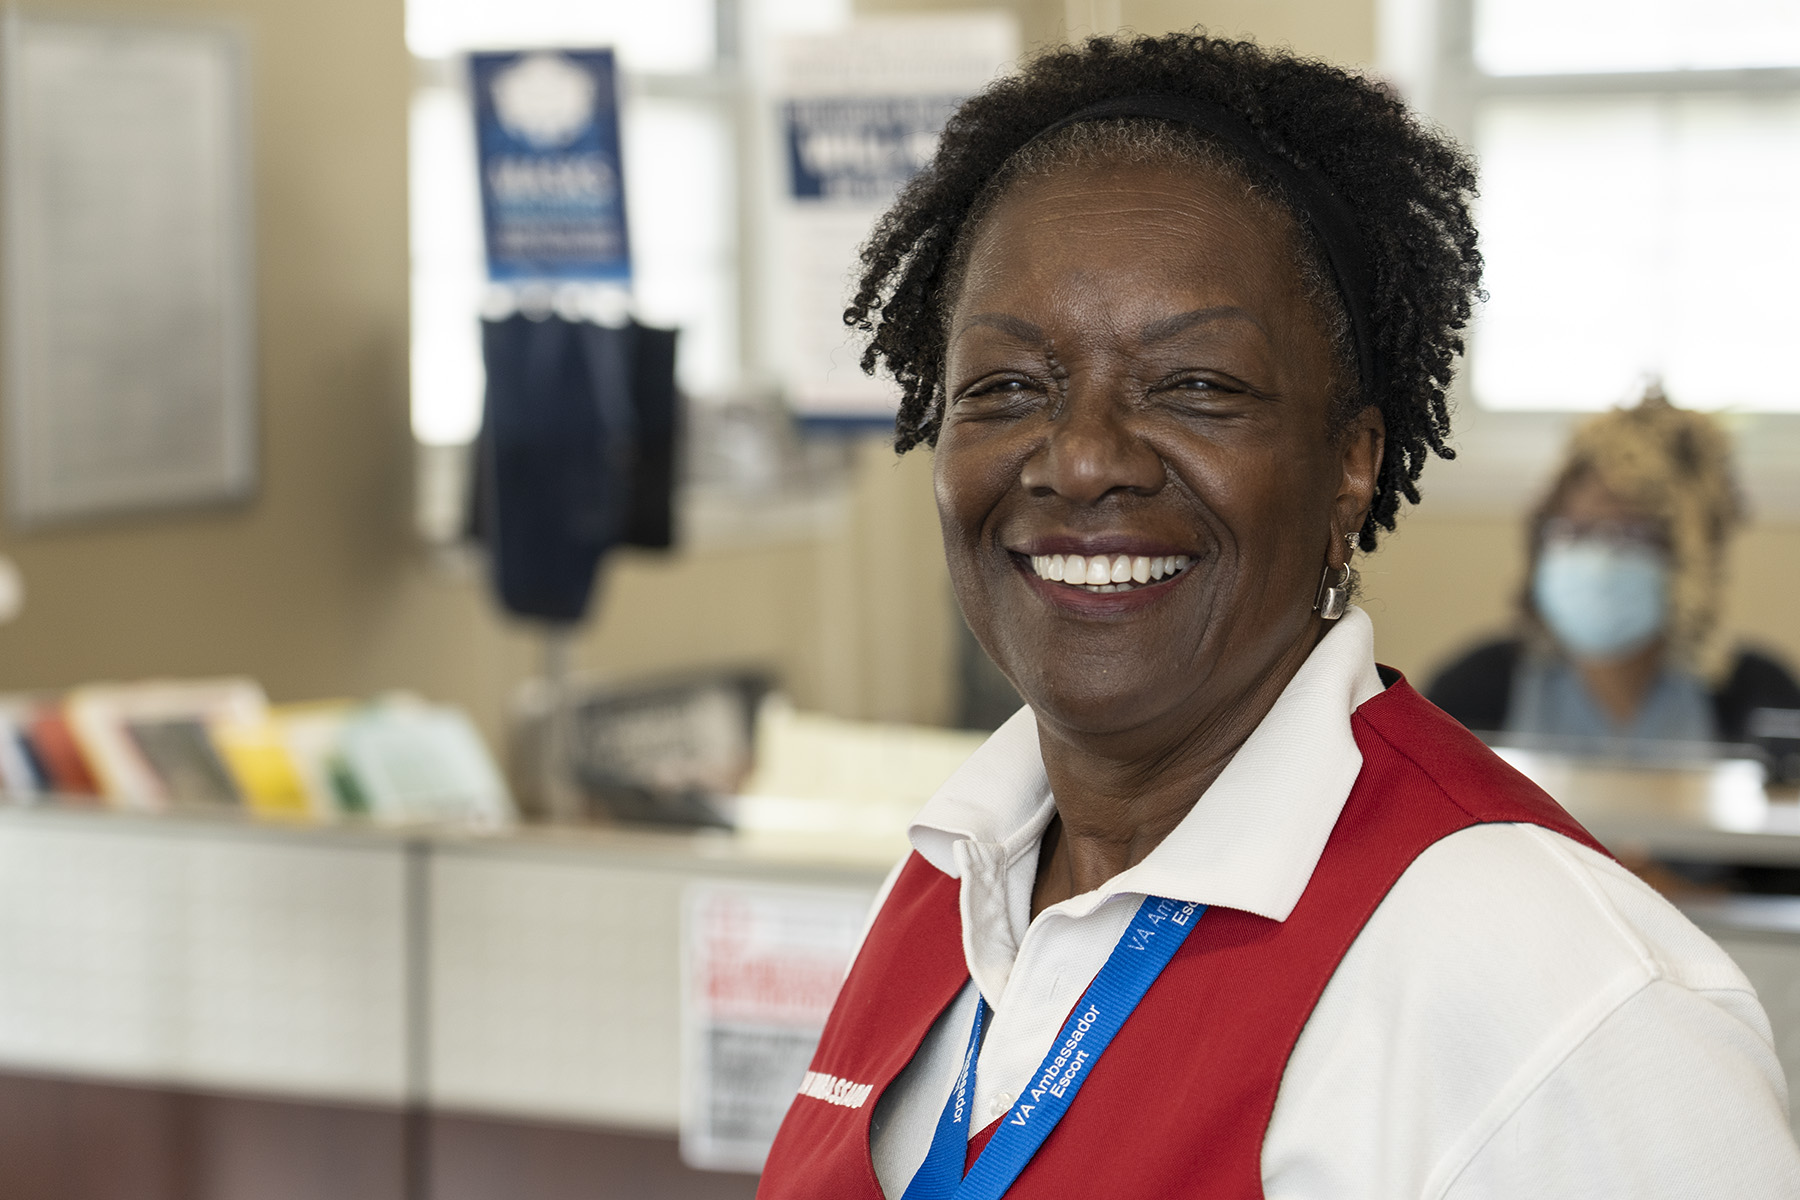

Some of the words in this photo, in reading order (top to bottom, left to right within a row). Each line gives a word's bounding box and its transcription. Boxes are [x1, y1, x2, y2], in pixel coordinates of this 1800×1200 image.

[1128, 928, 1155, 950] VA
[1148, 899, 1178, 928] Am
[1010, 1103, 1035, 1126] VA
[1031, 1004, 1100, 1102] Ambassador
[1049, 1050, 1089, 1098] Escort
